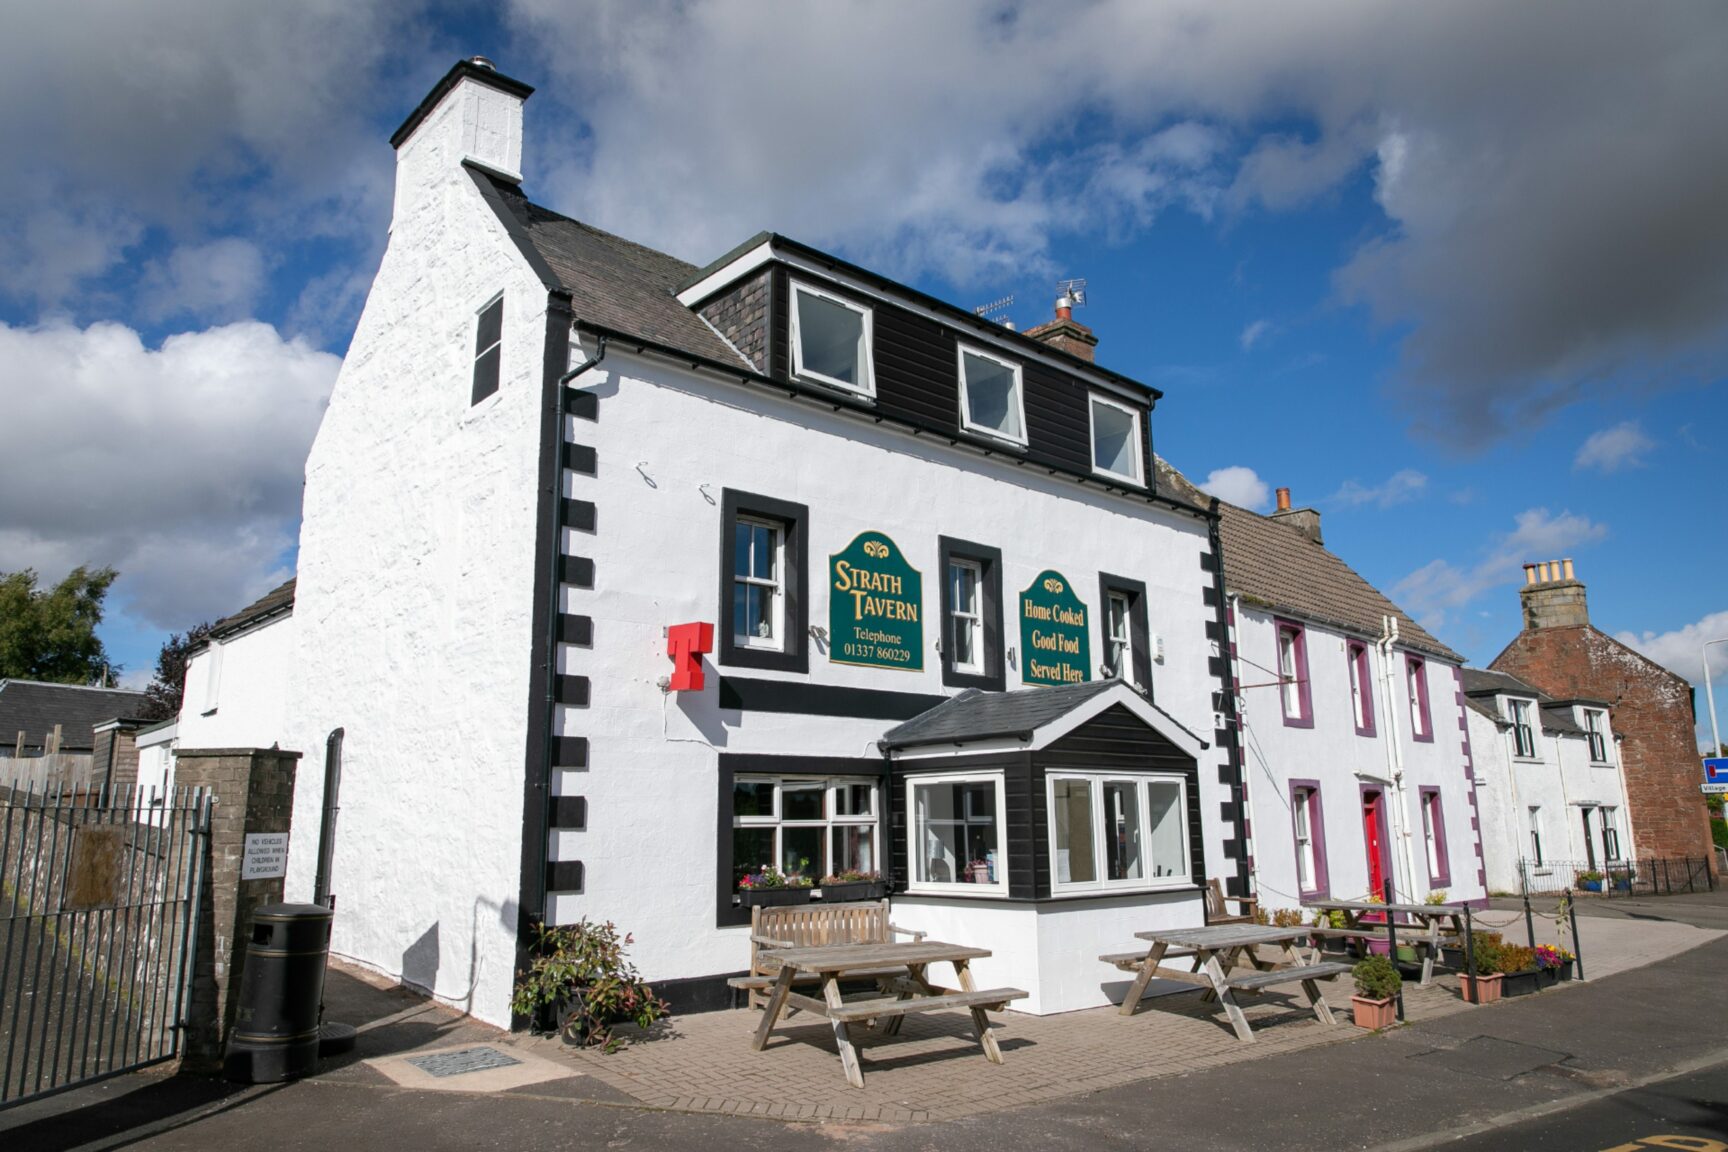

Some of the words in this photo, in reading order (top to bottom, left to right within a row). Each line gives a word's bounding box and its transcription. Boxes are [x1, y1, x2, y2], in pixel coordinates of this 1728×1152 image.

[835, 560, 903, 594] STRATH
[849, 589, 918, 622] TAVERN
[1024, 599, 1051, 620] Home
[1052, 604, 1084, 627] Cooked
[854, 627, 902, 644] Telephone
[1032, 629, 1056, 651] Good
[1058, 633, 1079, 653] Food
[667, 622, 714, 691] T
[844, 643, 874, 657] 01337
[877, 647, 910, 662] 860229
[1031, 659, 1061, 680] Served
[1063, 663, 1083, 682] Here
